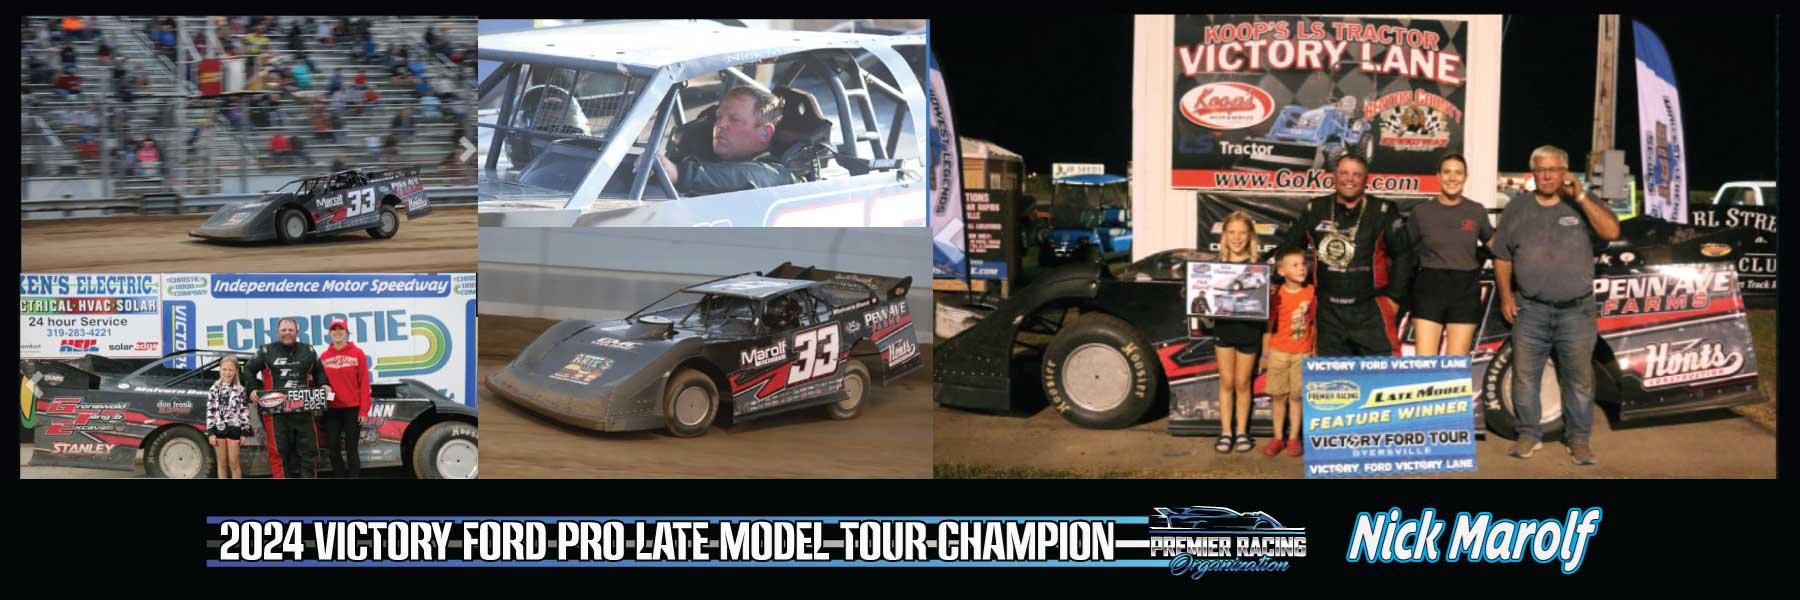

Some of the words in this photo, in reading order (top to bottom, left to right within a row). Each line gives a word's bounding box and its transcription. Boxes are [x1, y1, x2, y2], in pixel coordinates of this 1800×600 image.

[1204, 21, 1289, 44] KOOP'S
[1297, 21, 1325, 40] LS
[1332, 23, 1440, 50] TRACTOR
[1179, 39, 1349, 76] VICTORY
[1361, 42, 1466, 86] LANE
[1219, 141, 1275, 154] Tractor
[936, 152, 953, 217] LEGENDS
[1215, 169, 1420, 192] www.GoKo.com
[346, 187, 376, 217] 33
[76, 276, 153, 295] ELECTRIC
[213, 279, 320, 294] Independence
[322, 280, 369, 293] Motor
[370, 278, 449, 294] Speedway
[1593, 275, 1670, 302] PENN
[1670, 270, 1732, 298] AVE
[79, 300, 112, 312] HVAC
[117, 300, 157, 312] SOLAR
[1602, 292, 1710, 316] FARMS
[28, 317, 44, 327] 24
[47, 317, 78, 327] hour
[80, 316, 128, 327] Service
[864, 309, 888, 326] PENN
[889, 301, 906, 316] AVE
[46, 328, 113, 337] 319-283-4221
[108, 343, 134, 351] solar
[741, 340, 787, 366] Marolf
[787, 324, 840, 385] 33
[1306, 361, 1355, 371] VICTORY
[1360, 361, 1388, 370] FORD
[1391, 360, 1438, 369] VICTORY
[1440, 359, 1467, 368] LANE
[134, 386, 186, 395] Malvern
[288, 389, 326, 401] FEATURE
[1374, 390, 1413, 404] LATE
[1416, 385, 1467, 398] MODEL
[303, 400, 327, 410] 2024
[1309, 409, 1392, 430] FEATURE
[1398, 401, 1468, 419] WINNER
[51, 442, 115, 454] STANLEY
[1311, 434, 1381, 449] VICTORY
[1384, 433, 1425, 446] FORD
[1429, 431, 1470, 444] TOUR
[1352, 448, 1431, 457] DYERSVILLE
[1309, 464, 1360, 475] VICTORY
[1364, 462, 1393, 473] FORD
[1395, 460, 1442, 471] VICTORY
[1446, 459, 1474, 469] LANE
